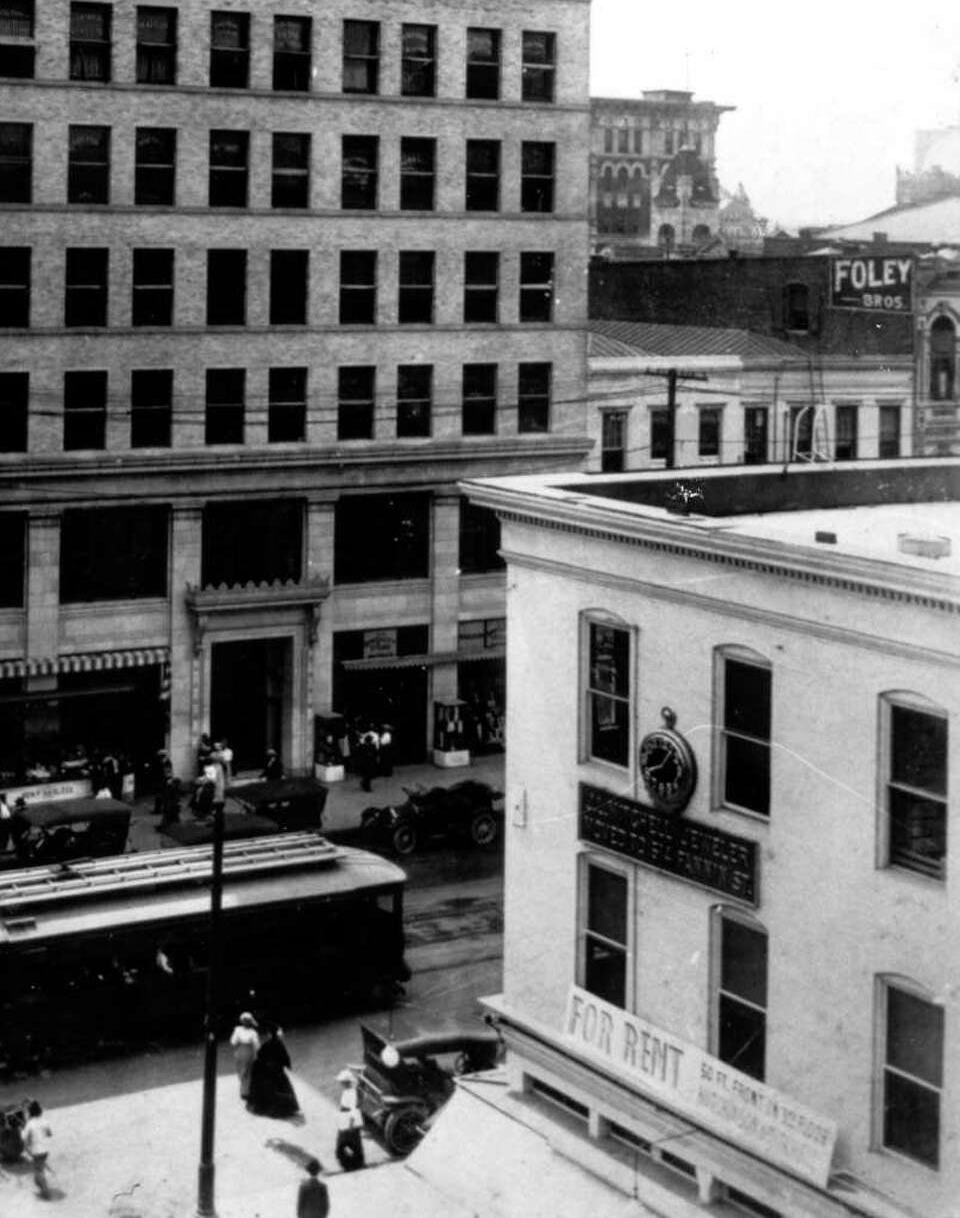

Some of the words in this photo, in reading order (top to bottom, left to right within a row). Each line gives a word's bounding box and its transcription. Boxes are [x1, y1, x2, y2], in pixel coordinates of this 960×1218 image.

[834, 258, 912, 293] FOLEY
[568, 994, 615, 1055] FOR
[623, 1021, 685, 1089] RENT
